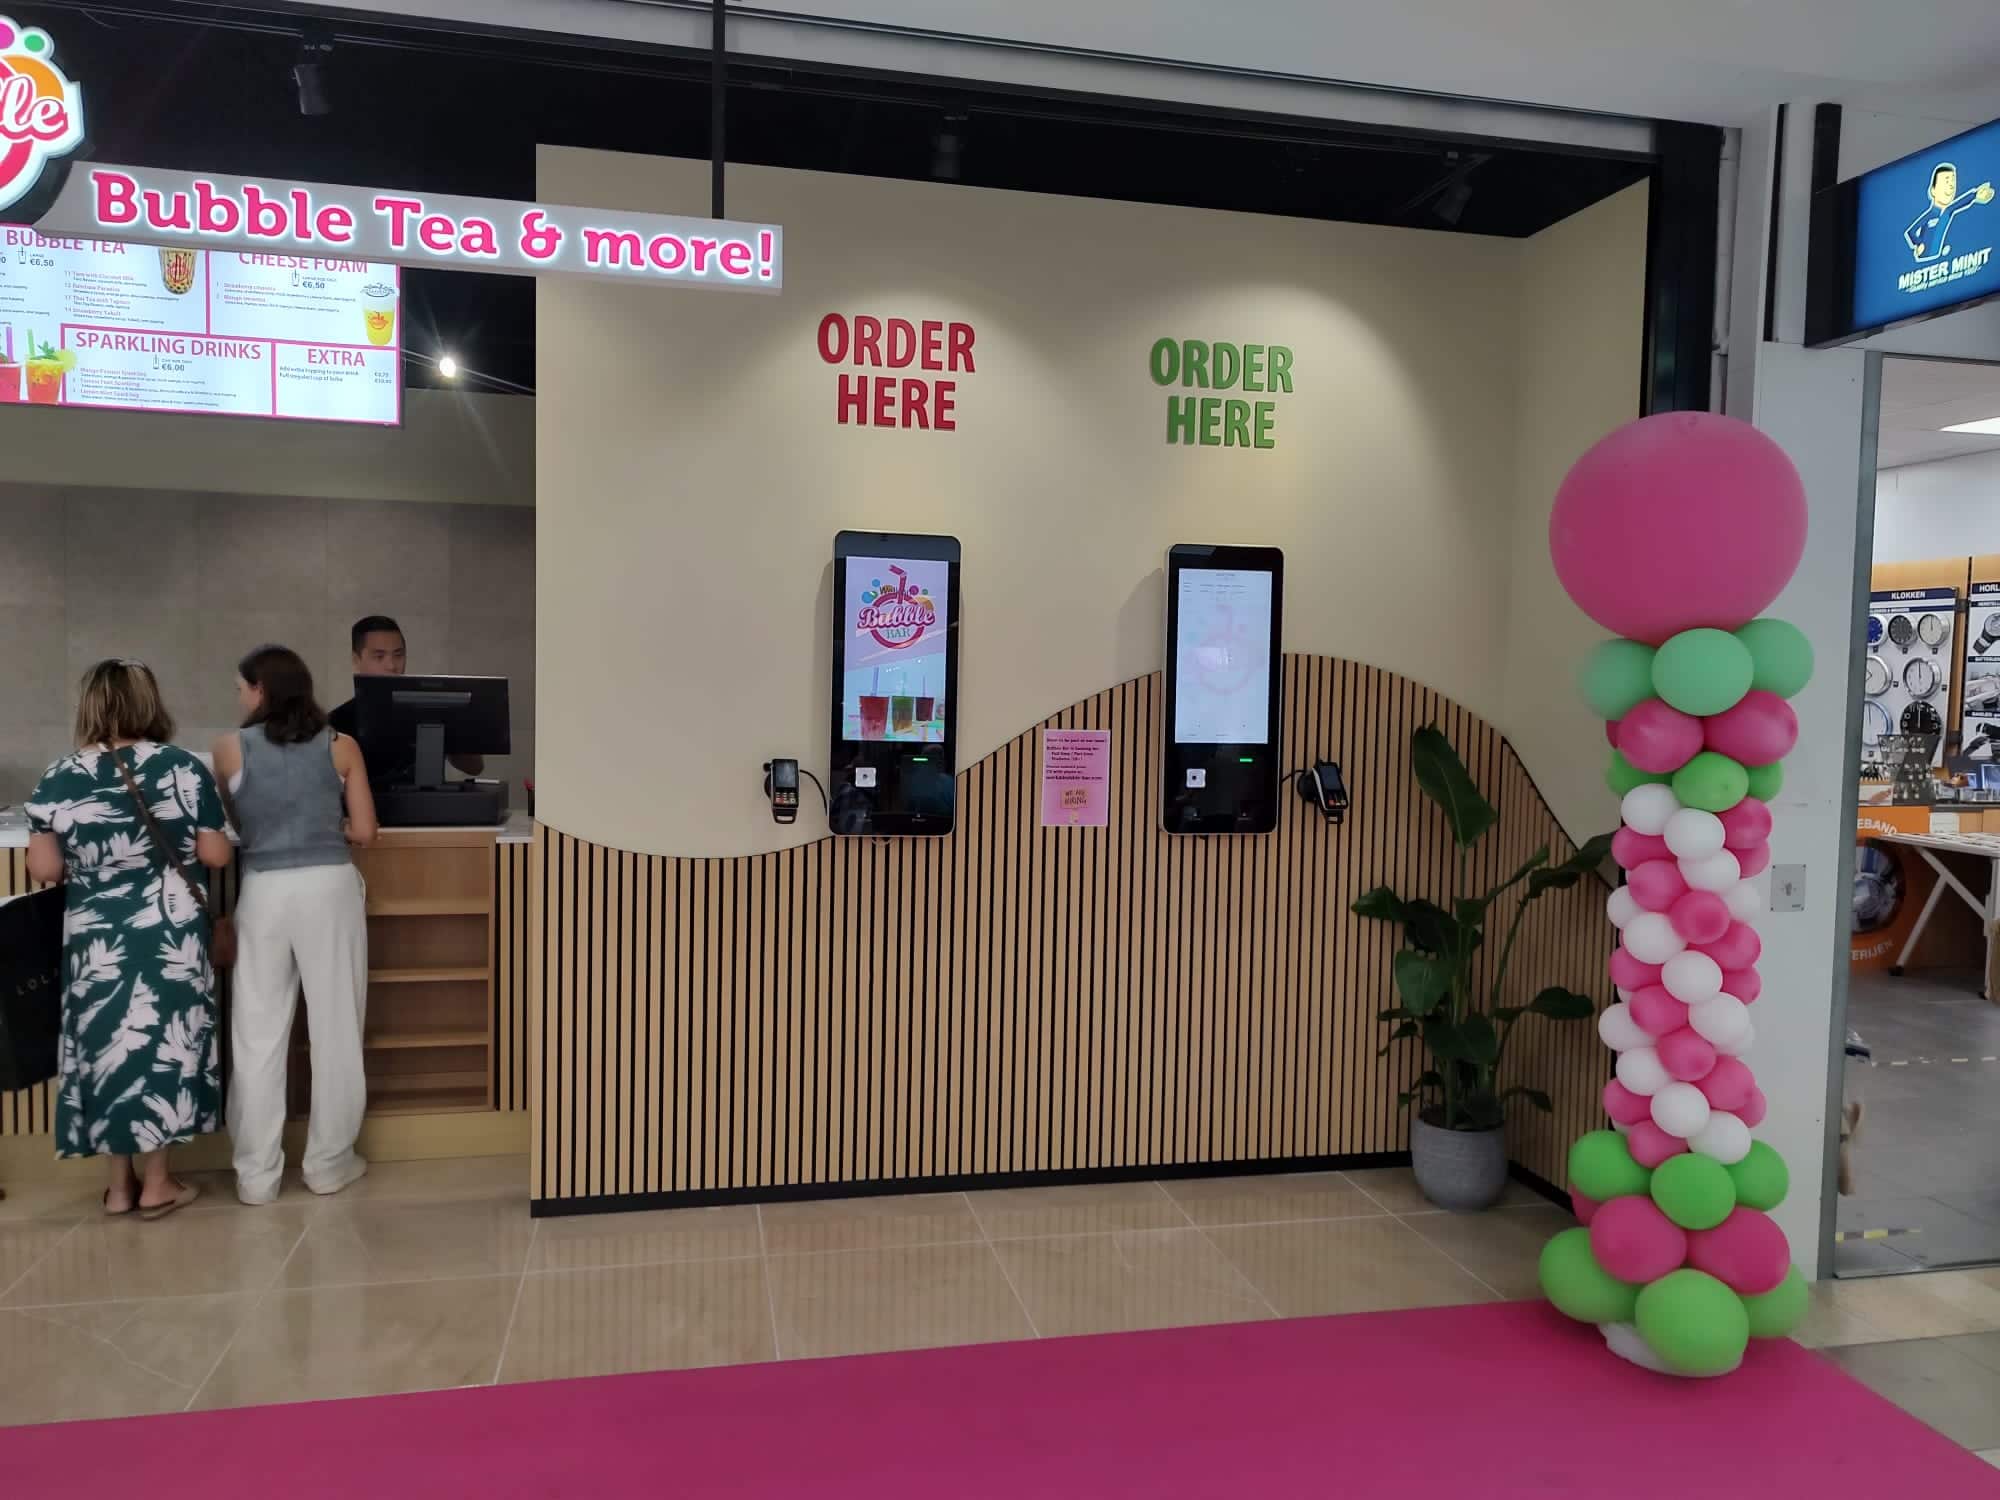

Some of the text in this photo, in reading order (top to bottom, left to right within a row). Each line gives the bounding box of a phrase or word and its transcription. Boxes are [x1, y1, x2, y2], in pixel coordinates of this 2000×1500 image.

[0, 73, 69, 141] le
[6, 229, 84, 251] BUBBLE
[92, 170, 773, 277] Bubble Tea & more!
[238, 252, 369, 274] CHEESE FOAM
[1898, 261, 1949, 290] MISTER
[1952, 247, 1993, 274] MINIT
[75, 331, 262, 360] SPARKLING DRINKS
[308, 348, 366, 367] EXTRA
[817, 312, 976, 373] ORDER
[1151, 337, 1294, 393] ORDER
[838, 374, 956, 431] HERE
[1167, 396, 1276, 449] HERE
[1891, 590, 1926, 600] KLOKKEN
[857, 605, 936, 629] Bubble
[1857, 818, 1898, 835] EBAND
